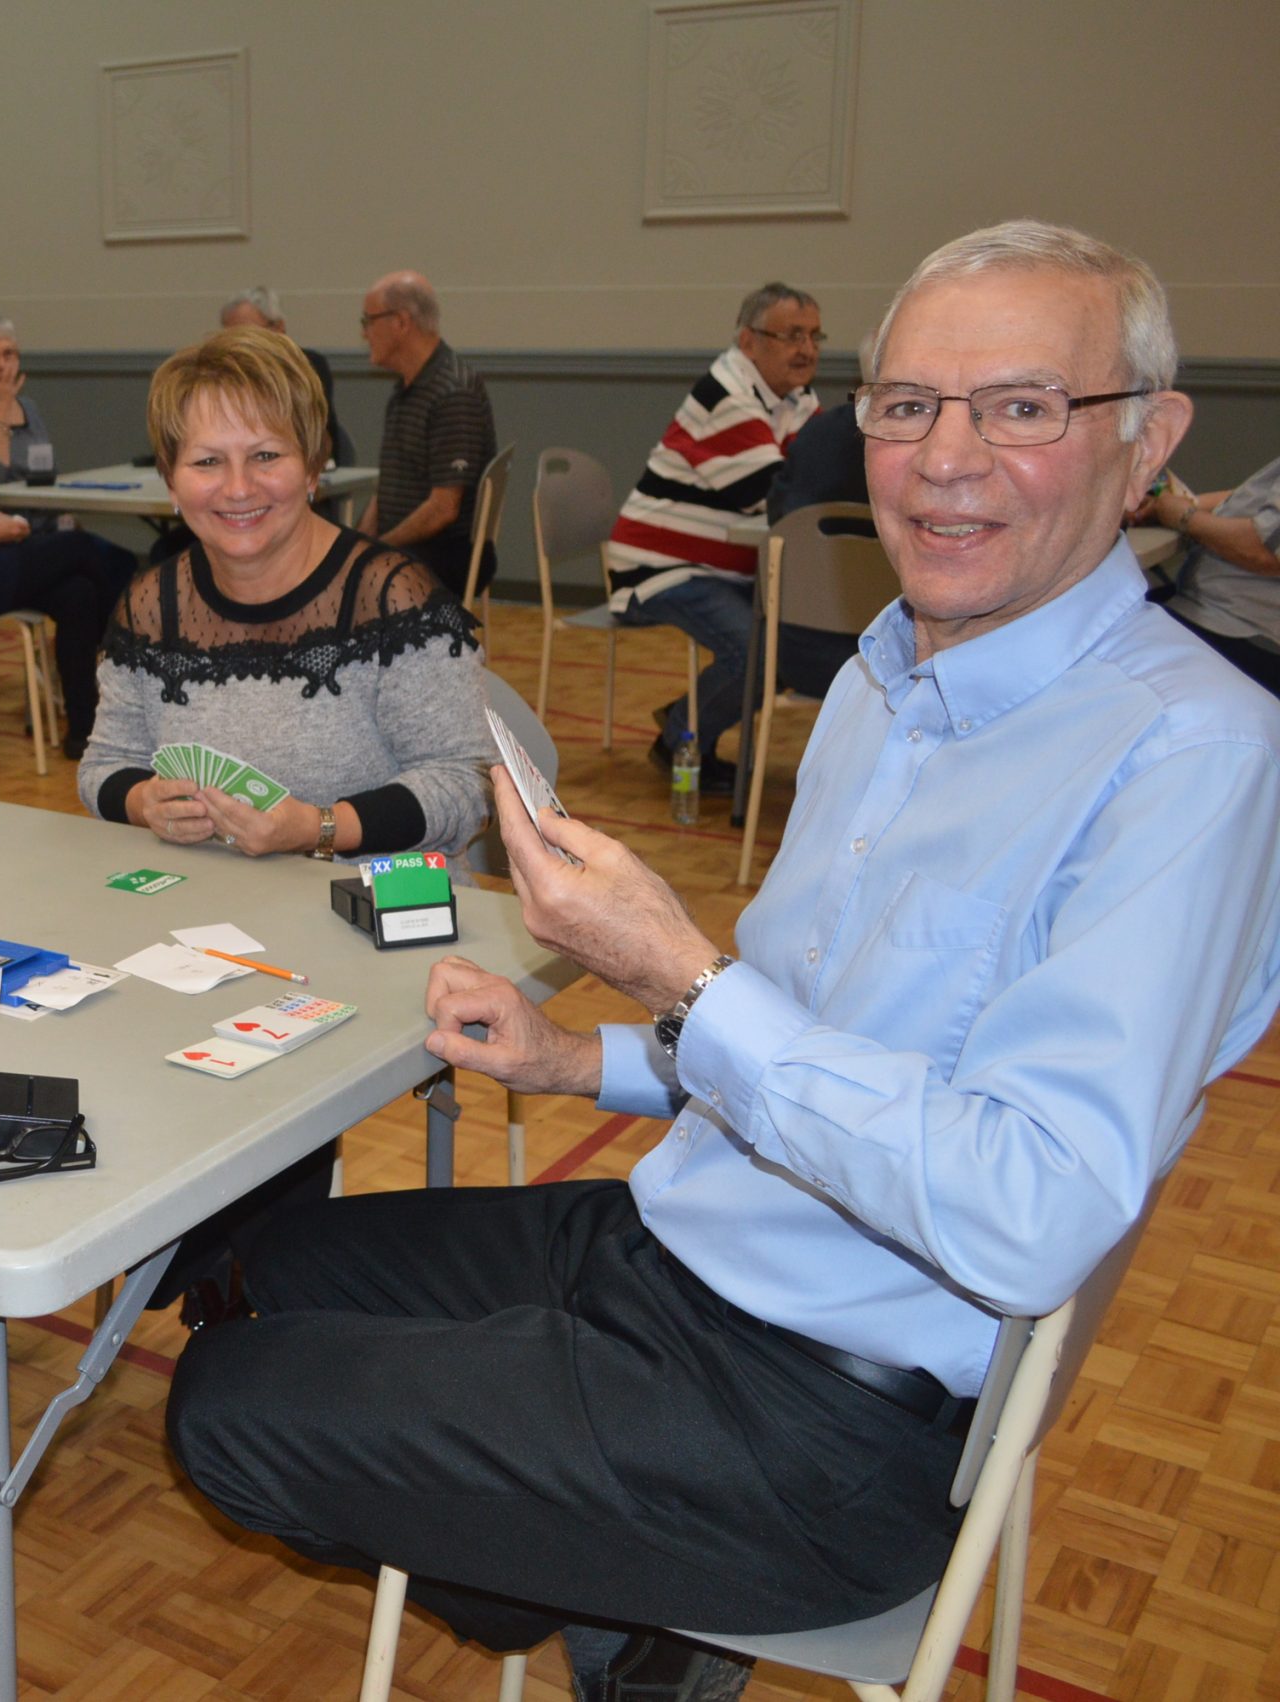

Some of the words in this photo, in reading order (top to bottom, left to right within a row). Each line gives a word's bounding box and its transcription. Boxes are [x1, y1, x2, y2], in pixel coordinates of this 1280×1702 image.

[373, 860, 392, 874] XX
[395, 857, 423, 869] PASS
[426, 856, 438, 869] X
[261, 1028, 290, 1040] 7
[209, 1057, 236, 1067] 1
